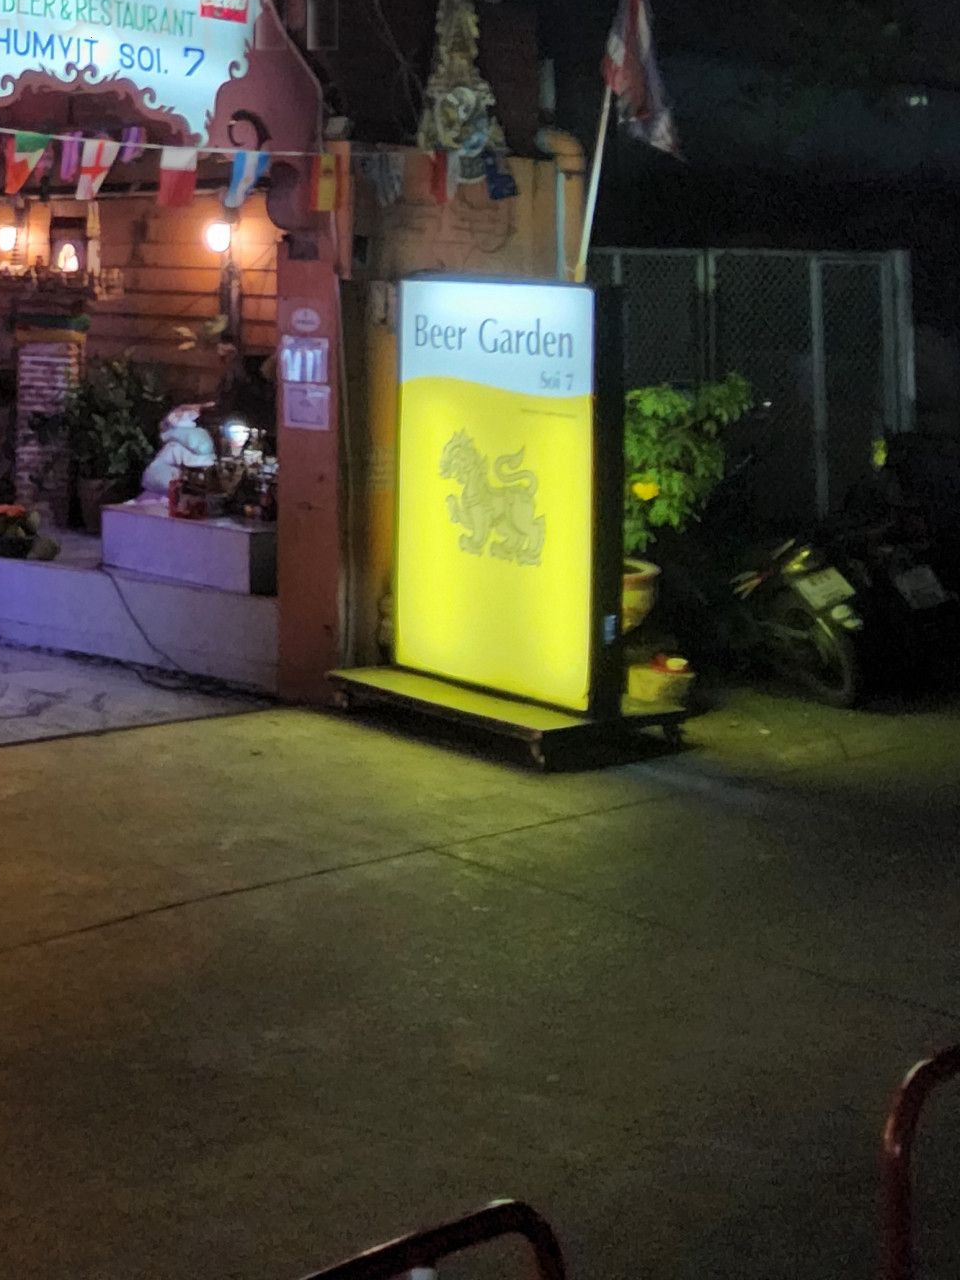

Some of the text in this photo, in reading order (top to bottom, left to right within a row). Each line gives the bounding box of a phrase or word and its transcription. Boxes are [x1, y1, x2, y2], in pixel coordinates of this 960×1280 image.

[183, 47, 206, 78] 7
[414, 314, 575, 359] Beer Garden
[565, 372, 575, 391] 7
